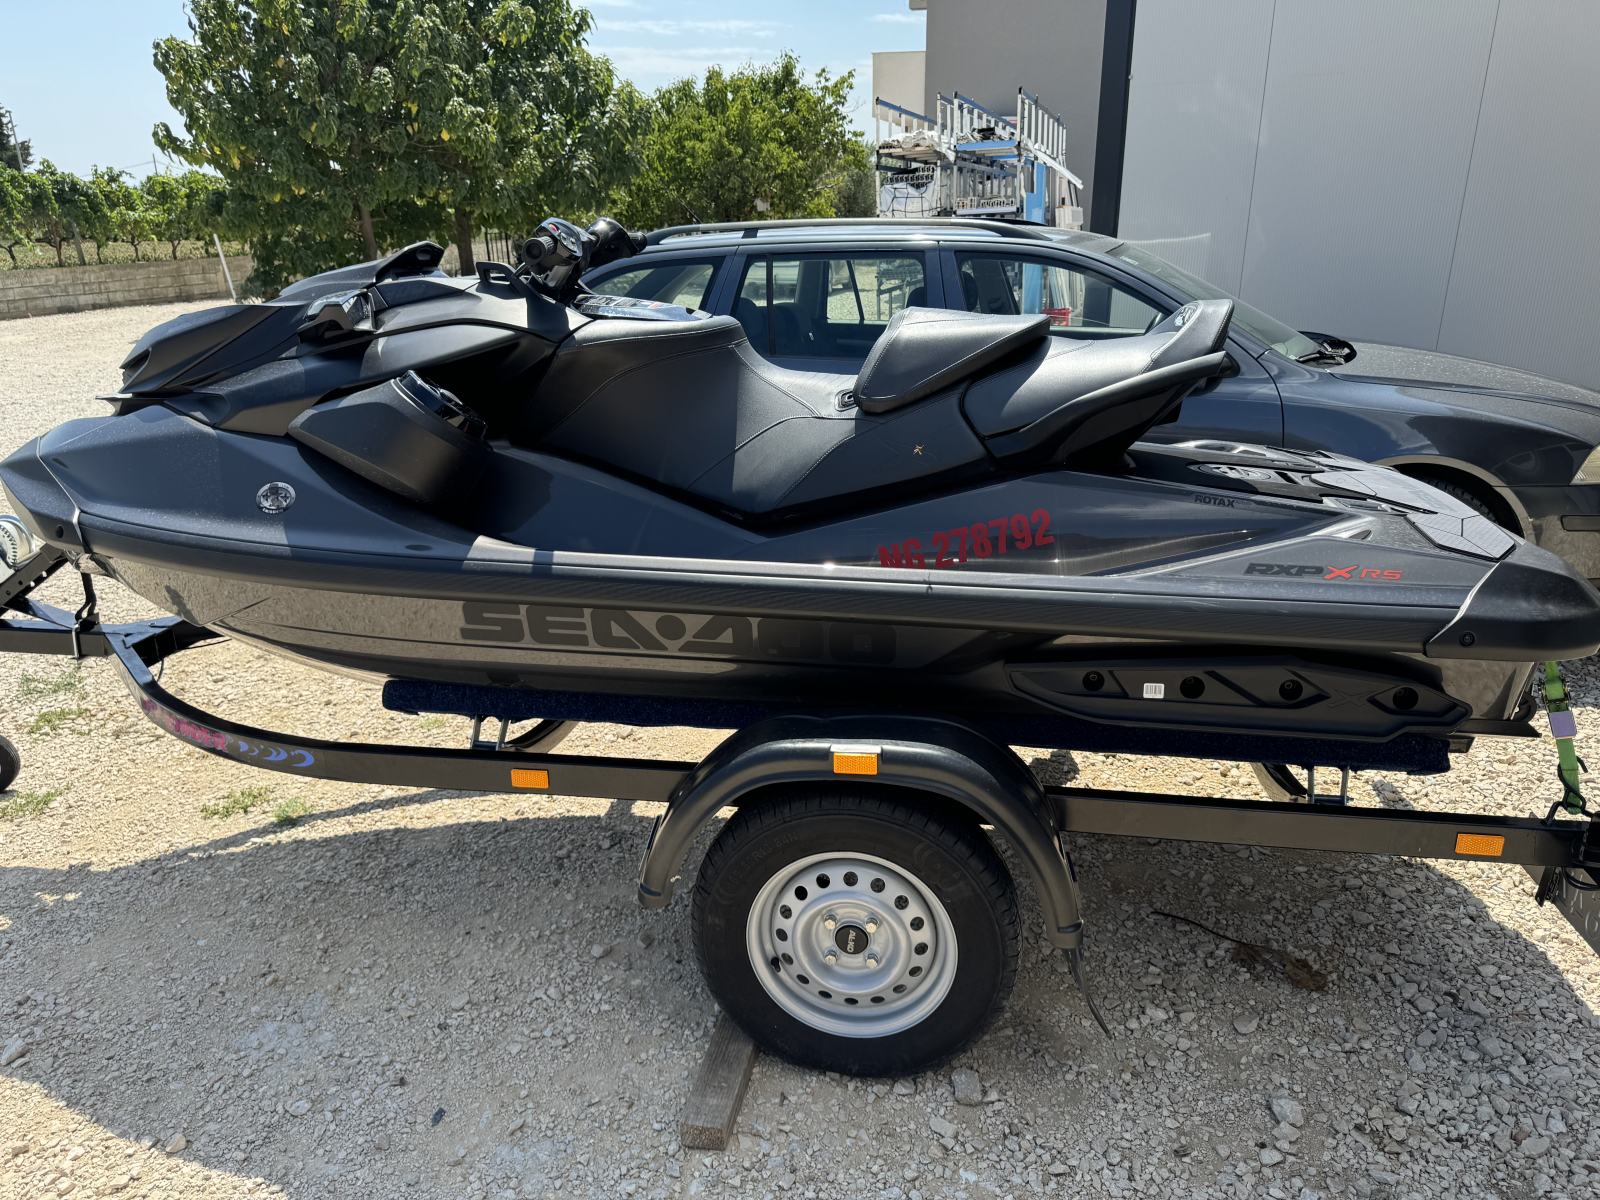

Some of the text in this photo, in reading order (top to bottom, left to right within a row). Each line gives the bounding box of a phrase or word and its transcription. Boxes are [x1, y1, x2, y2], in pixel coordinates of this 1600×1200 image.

[1194, 494, 1236, 508] ROTAX
[878, 508, 1055, 569] NG 278792
[1360, 568, 1405, 581] RS
[846, 929, 857, 953] AL-KO
